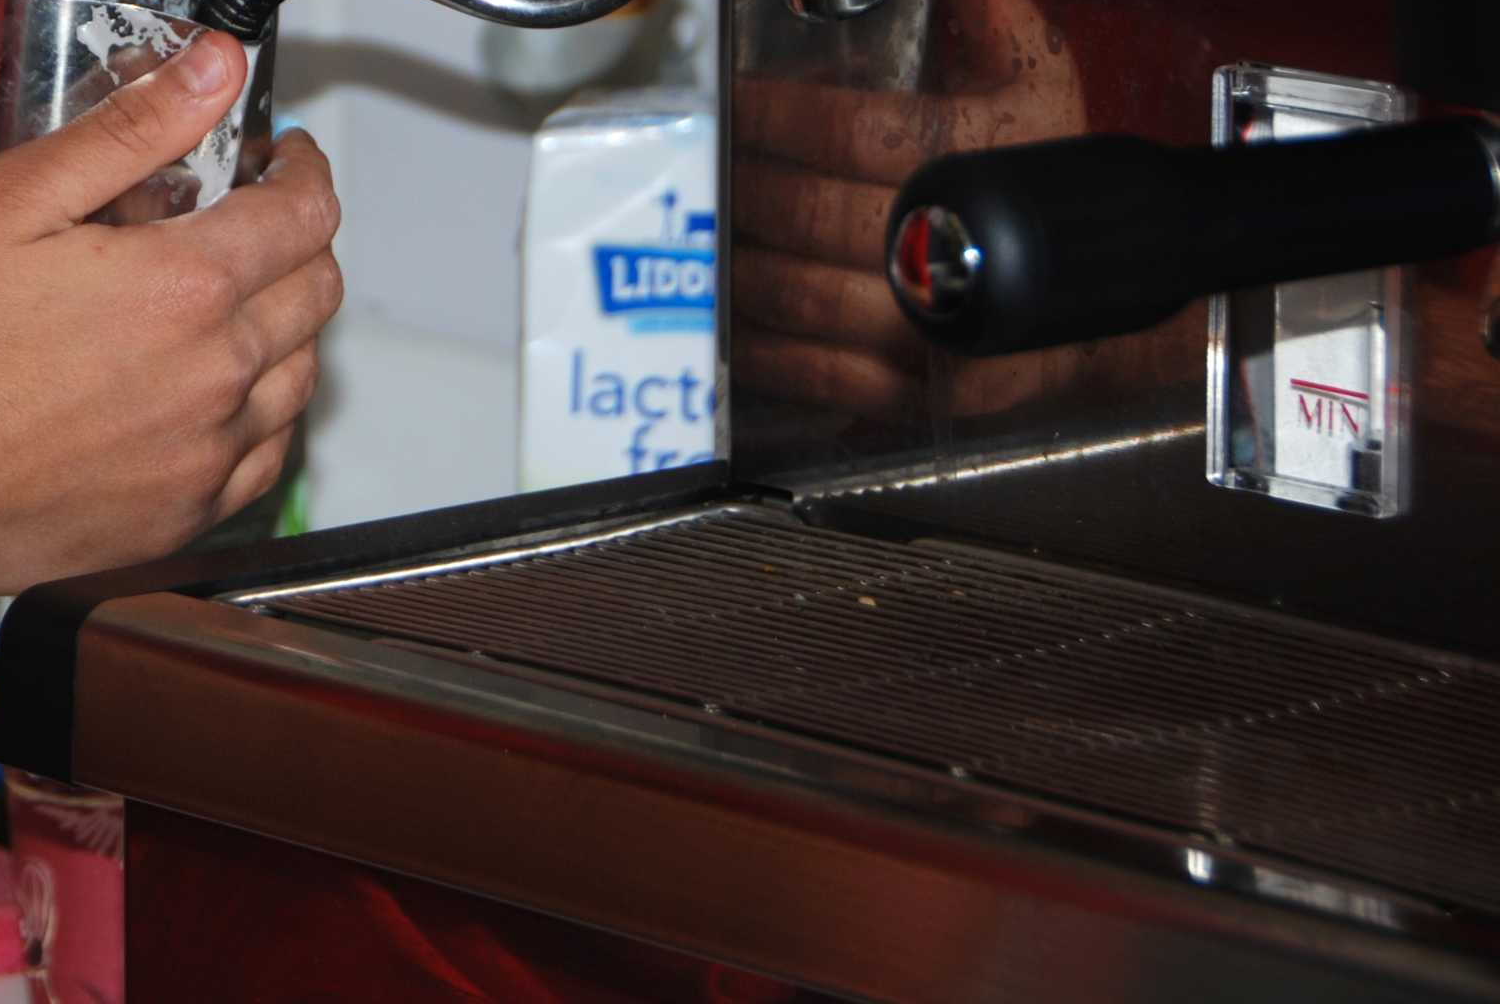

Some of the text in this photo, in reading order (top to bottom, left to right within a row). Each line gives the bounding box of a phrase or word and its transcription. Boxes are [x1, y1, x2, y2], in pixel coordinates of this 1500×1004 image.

[569, 347, 717, 423] lact
[1298, 393, 1365, 437] MIN
[625, 420, 717, 476] fr
